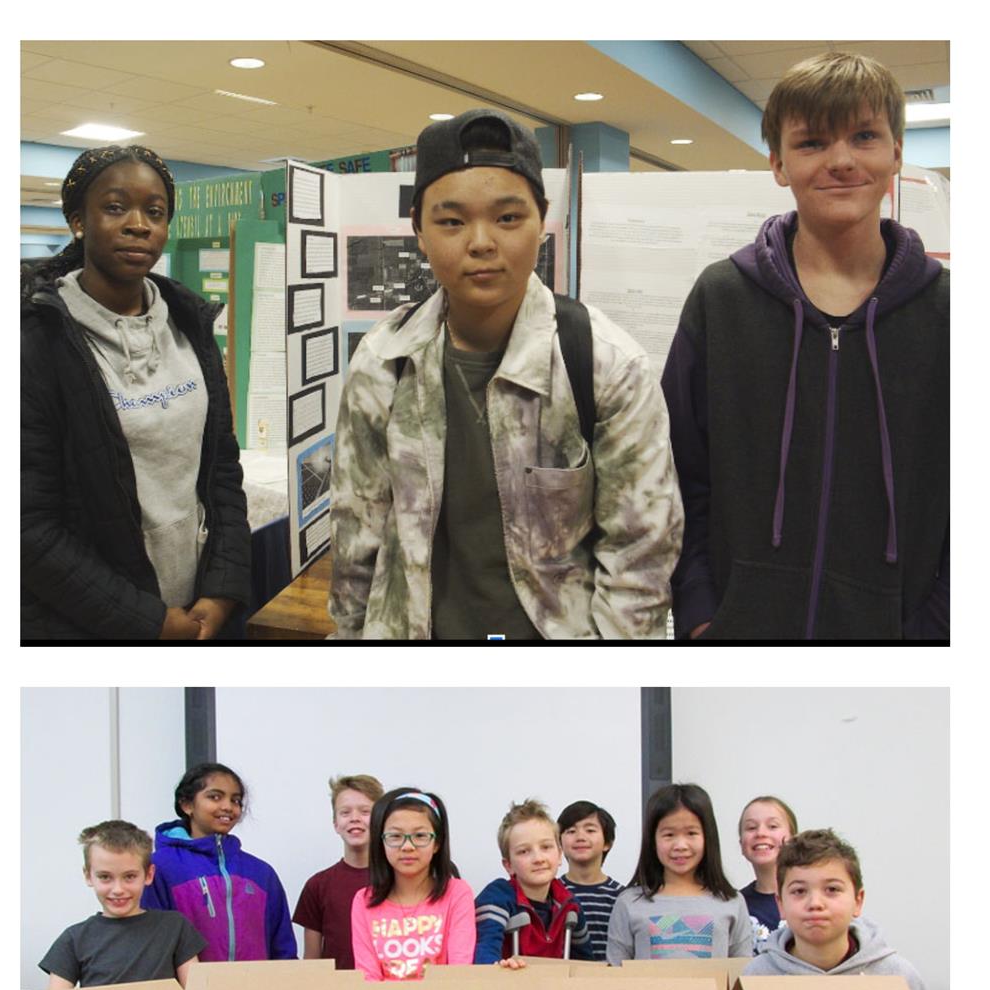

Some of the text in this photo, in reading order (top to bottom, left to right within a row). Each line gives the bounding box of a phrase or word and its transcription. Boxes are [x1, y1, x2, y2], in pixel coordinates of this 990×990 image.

[339, 156, 371, 174] SAFE
[109, 381, 196, 410] Champion
[372, 915, 443, 937] HAPPY
[372, 934, 443, 959] LOOKS
